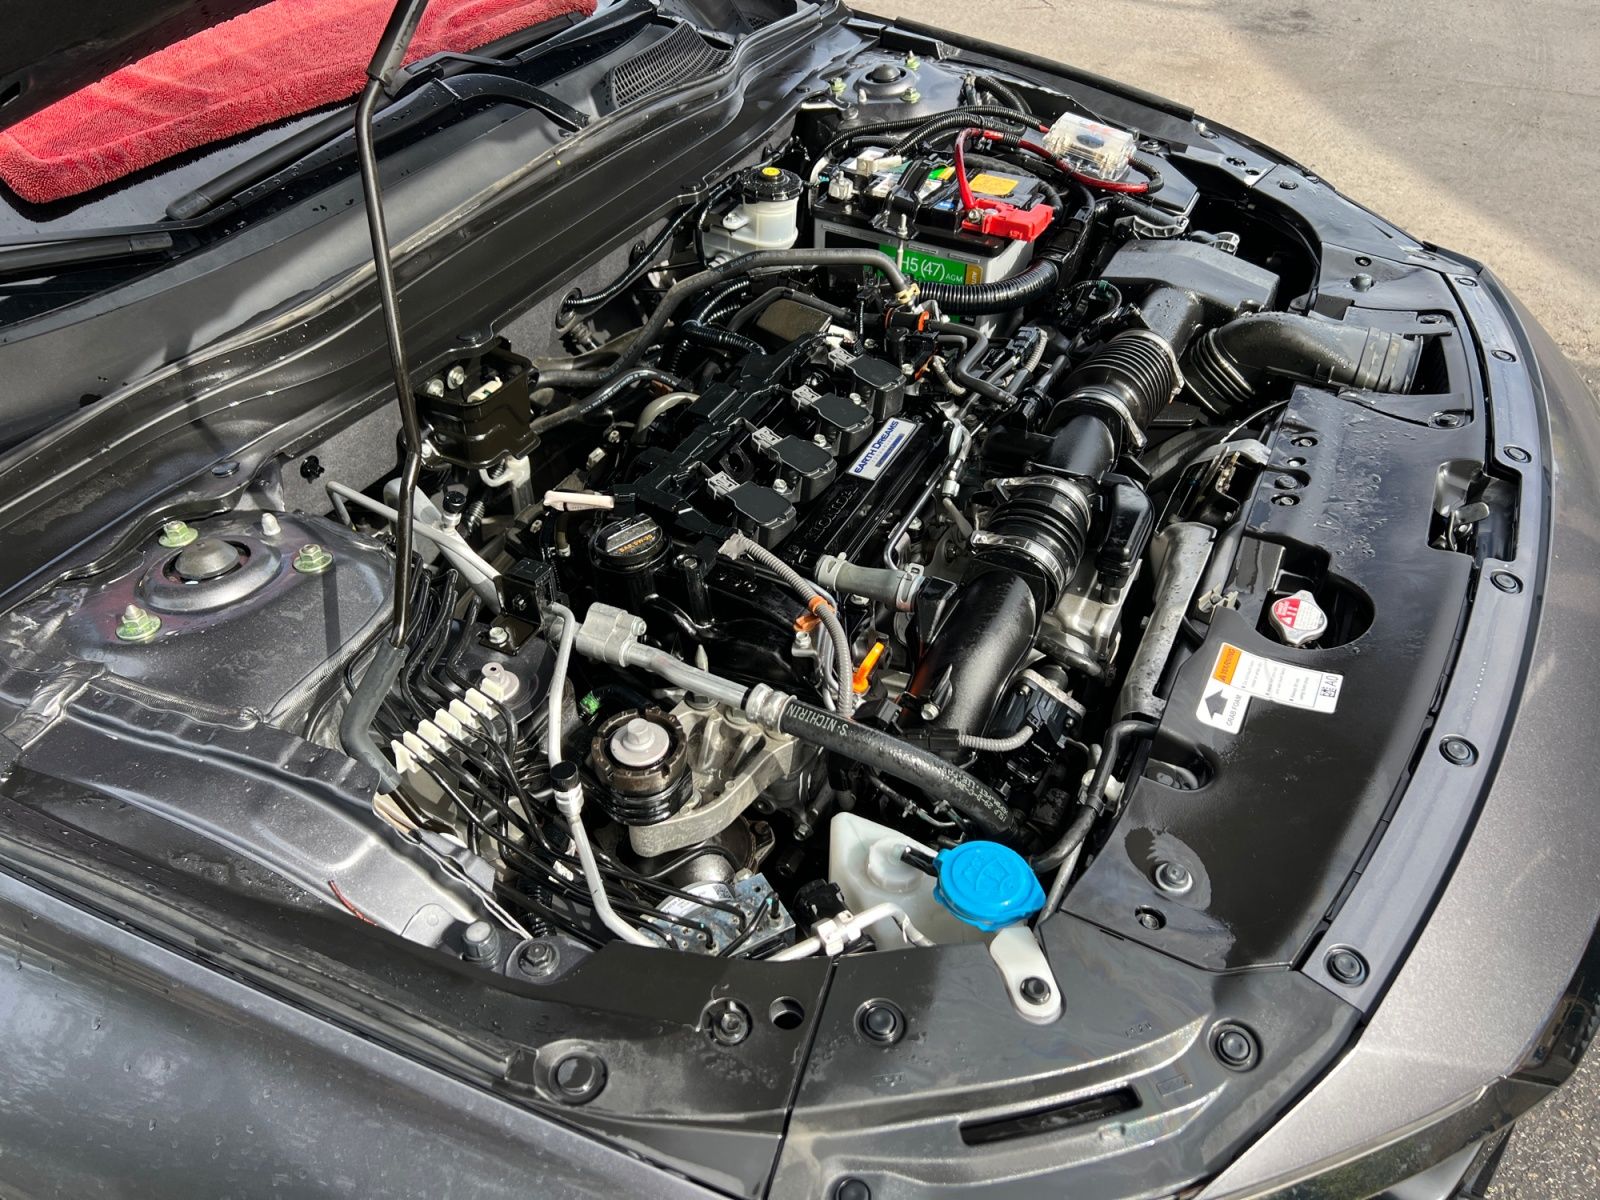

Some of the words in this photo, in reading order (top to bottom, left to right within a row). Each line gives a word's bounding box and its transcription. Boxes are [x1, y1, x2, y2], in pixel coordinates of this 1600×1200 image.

[920, 259, 946, 282] (47)
[945, 273, 963, 282] AGM
[854, 449, 877, 473] EARTH
[871, 420, 899, 450] DREAMS
[1222, 648, 1236, 674] WARNING
[1226, 711, 1237, 727] GRAB
[1232, 694, 1242, 711] FOAM
